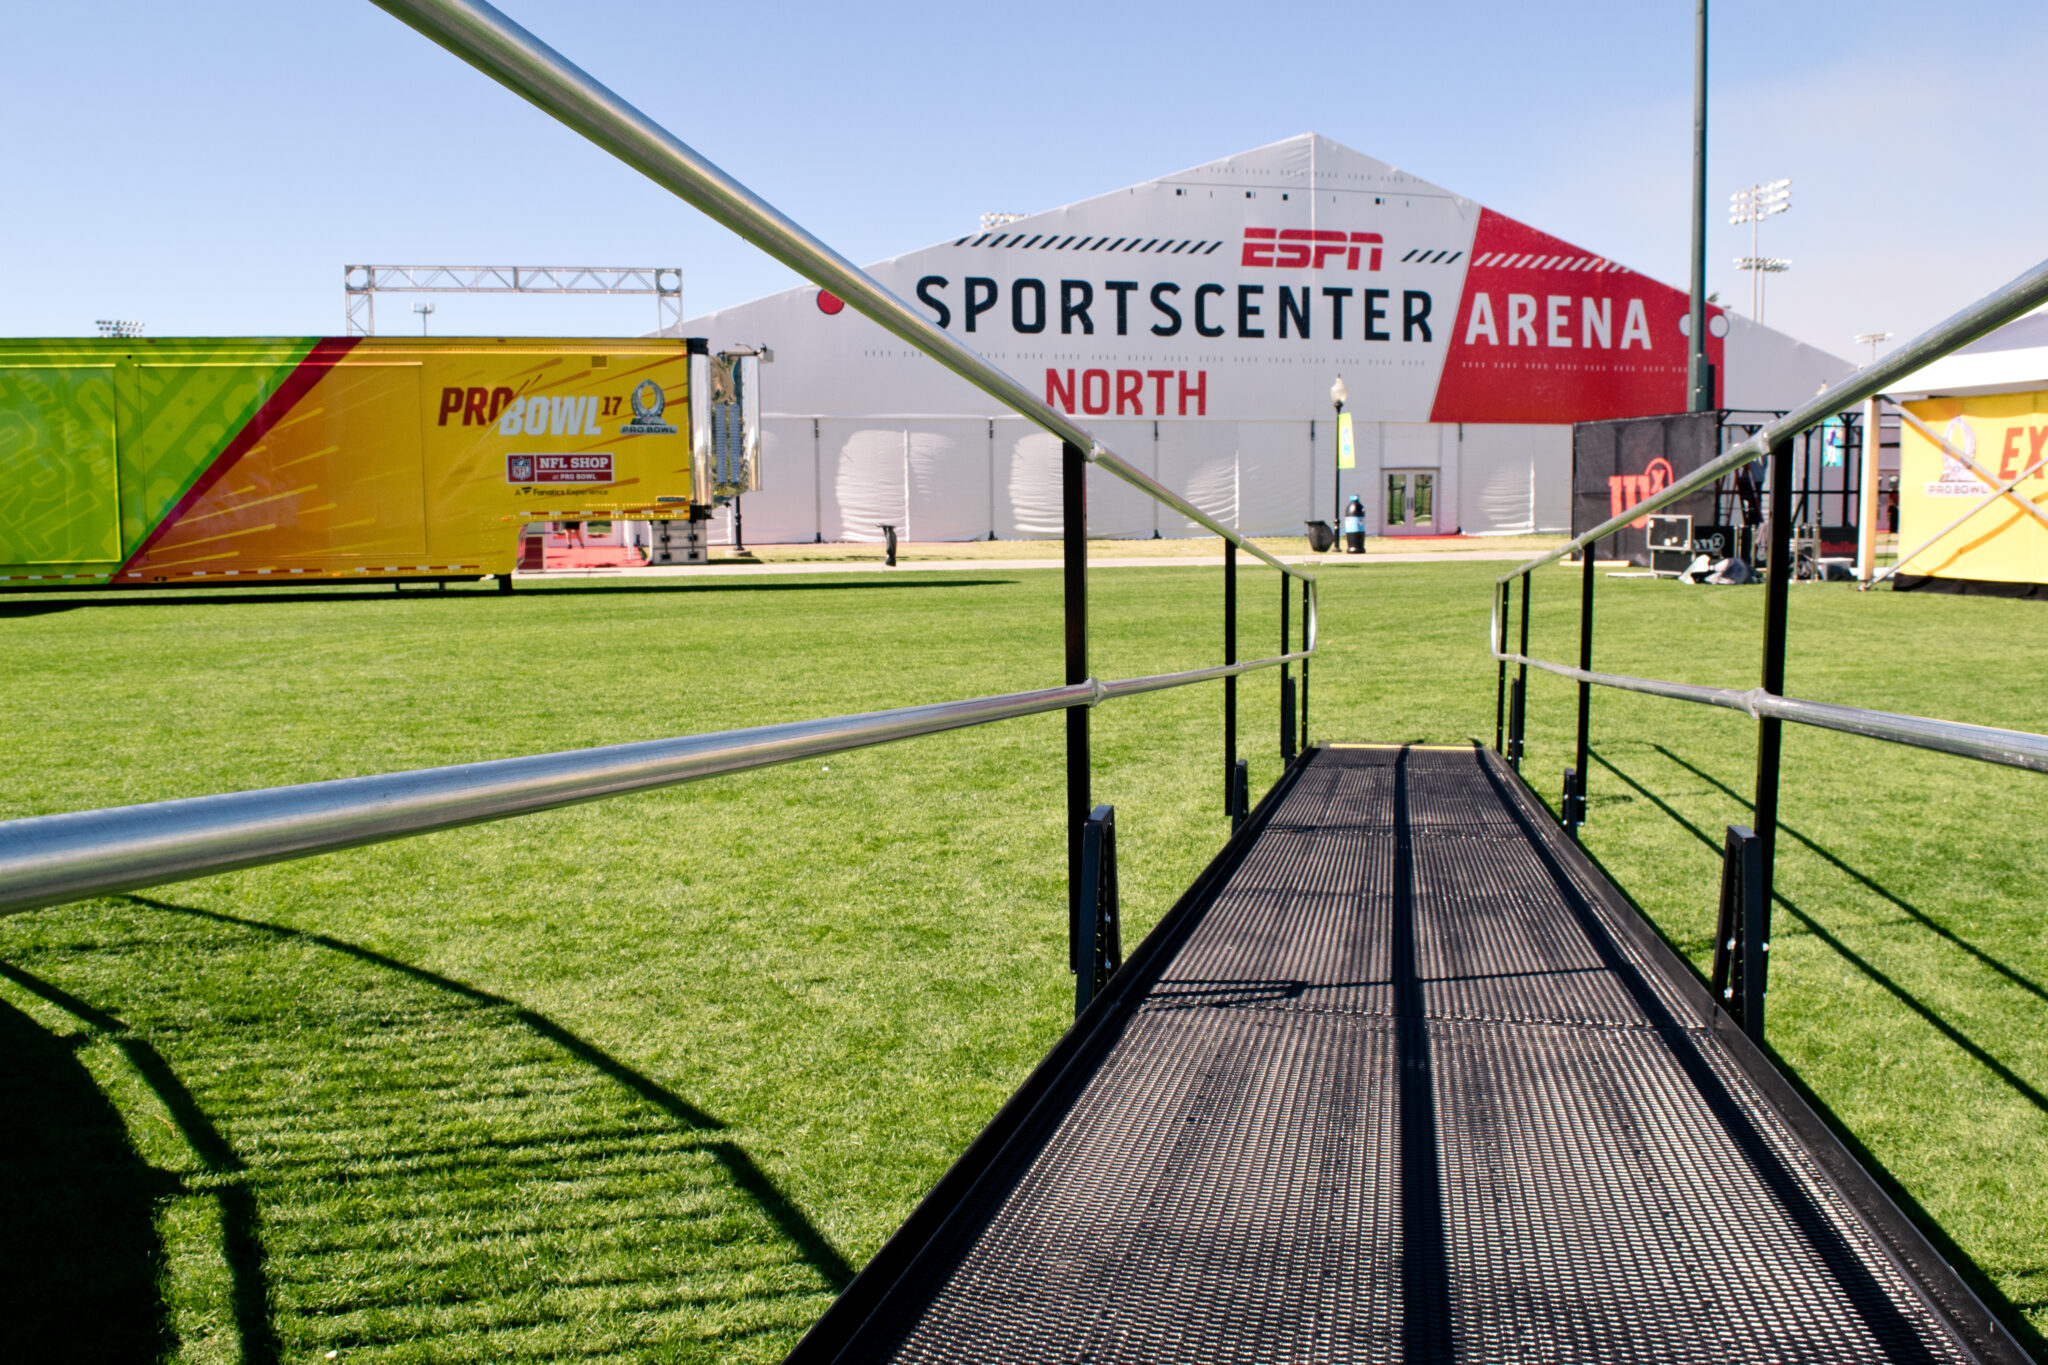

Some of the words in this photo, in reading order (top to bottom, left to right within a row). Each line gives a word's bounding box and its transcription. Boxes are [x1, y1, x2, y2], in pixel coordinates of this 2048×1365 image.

[1241, 227, 1384, 272] ESPN
[916, 275, 1433, 343] SPORTSCENTER
[1464, 292, 1652, 351] ARENA
[1046, 367, 1206, 416] NORTH
[438, 386, 515, 427] PRO
[499, 395, 602, 436] BOWL
[601, 396, 623, 416] 17
[622, 425, 644, 434] PRO
[646, 425, 677, 434] BOWL
[539, 457, 568, 469] NFL
[570, 457, 609, 469] SHOP
[533, 488, 565, 496] Fanatics
[566, 488, 609, 496] Experience
[1928, 485, 1953, 495] PRO
[1953, 485, 1988, 495] BOWL
